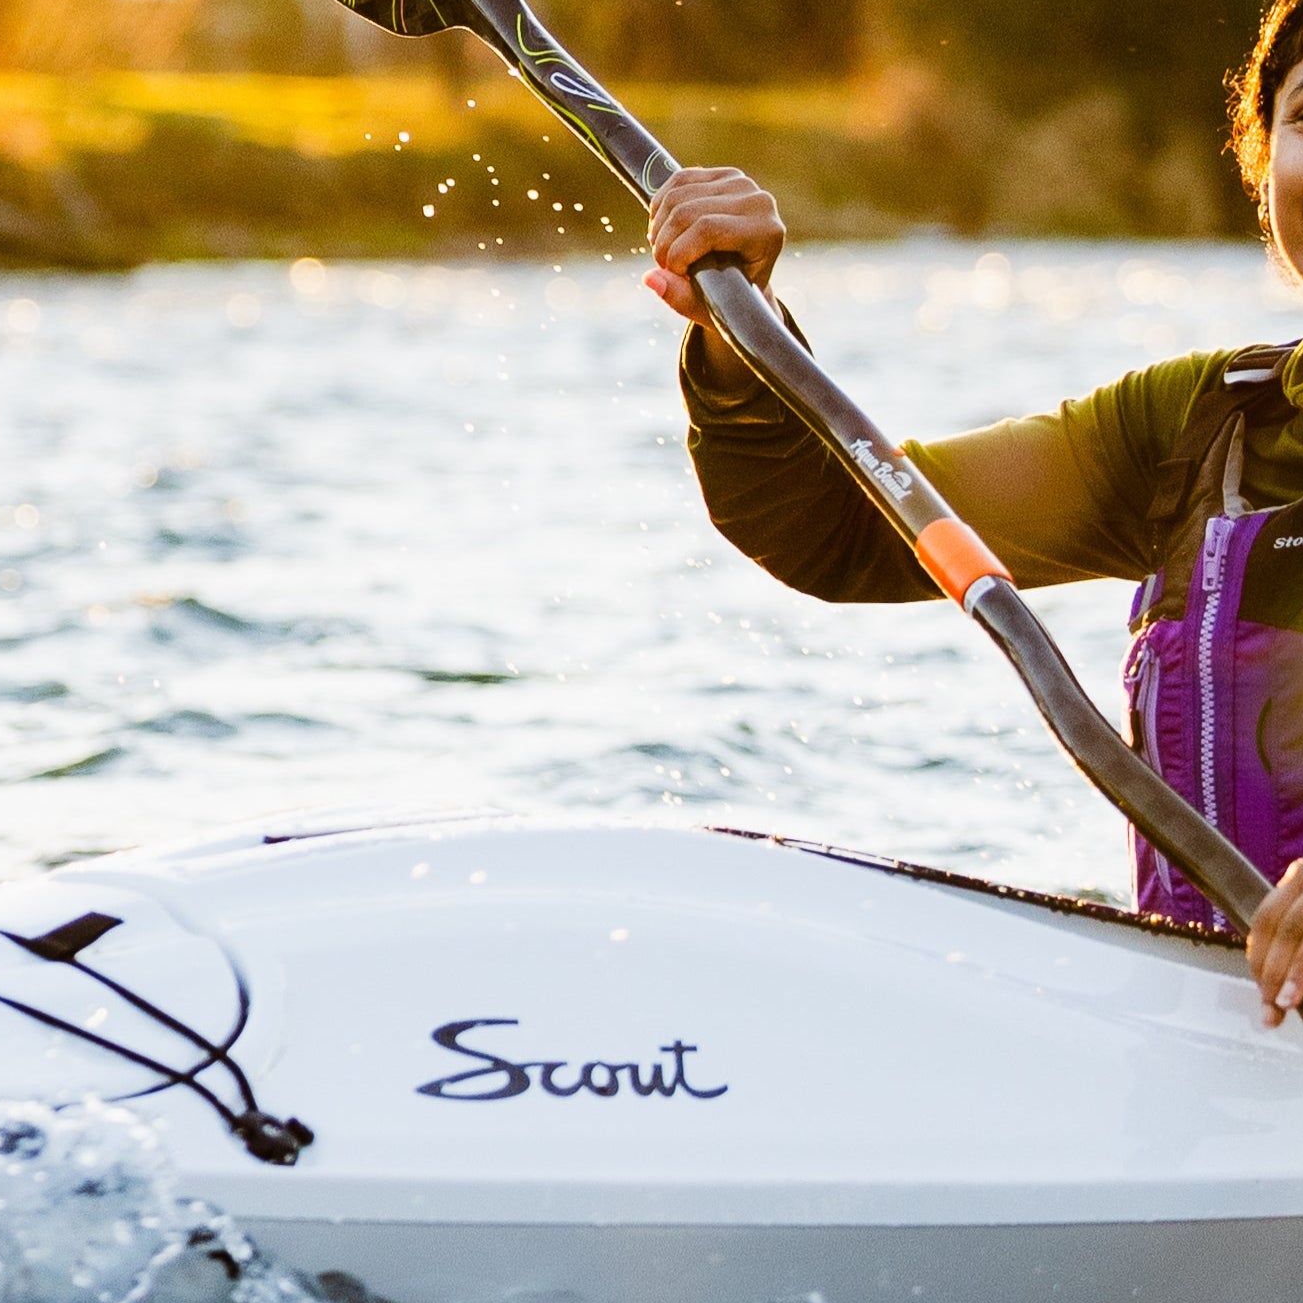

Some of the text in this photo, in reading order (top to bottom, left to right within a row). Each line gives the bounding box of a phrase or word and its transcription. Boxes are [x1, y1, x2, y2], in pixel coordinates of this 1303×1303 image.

[849, 438, 913, 502] Aqua Bound
[415, 1018, 728, 1100] Scout
